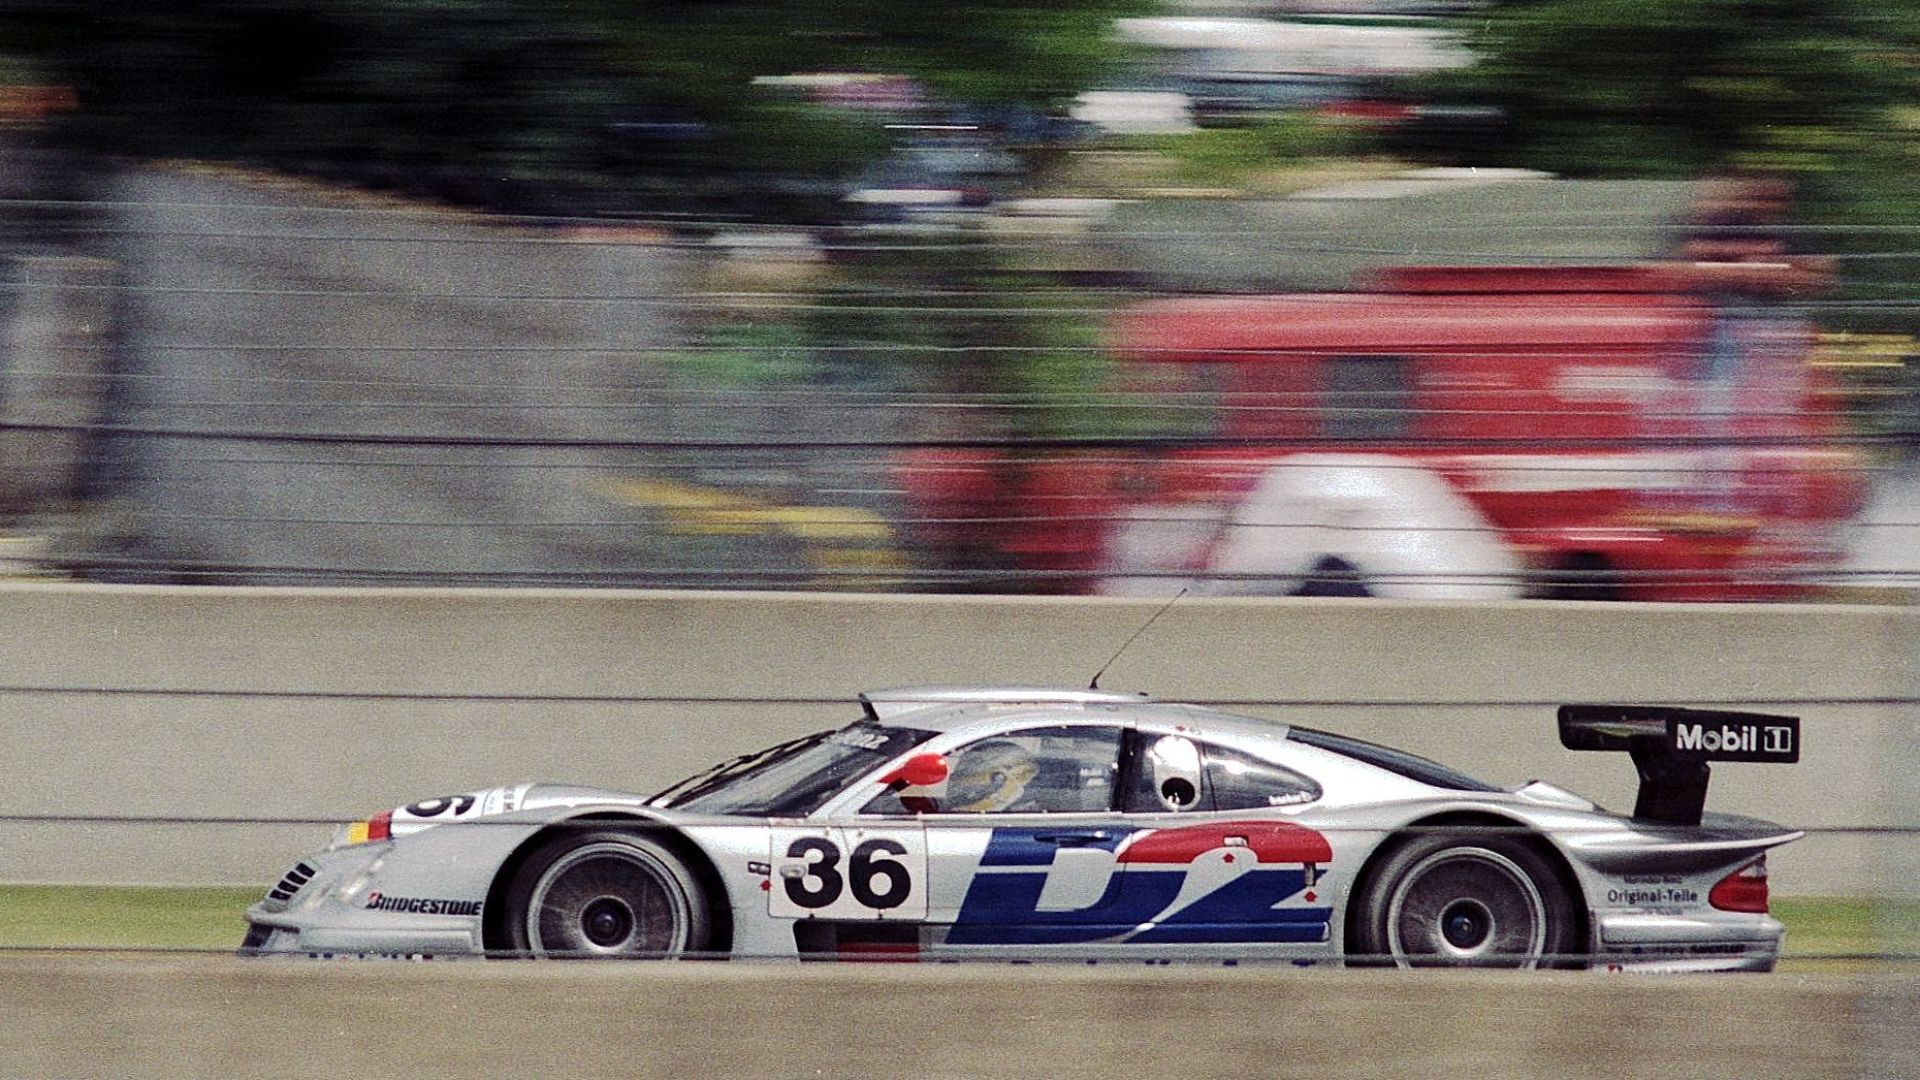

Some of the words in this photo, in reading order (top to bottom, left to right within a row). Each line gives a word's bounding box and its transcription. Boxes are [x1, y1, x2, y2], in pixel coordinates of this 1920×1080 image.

[1677, 724, 1757, 751] Mobil
[1764, 726, 1791, 752] 1
[783, 837, 911, 910] 36
[945, 821, 1333, 944] D2
[366, 891, 483, 916] BRIDGESTONE
